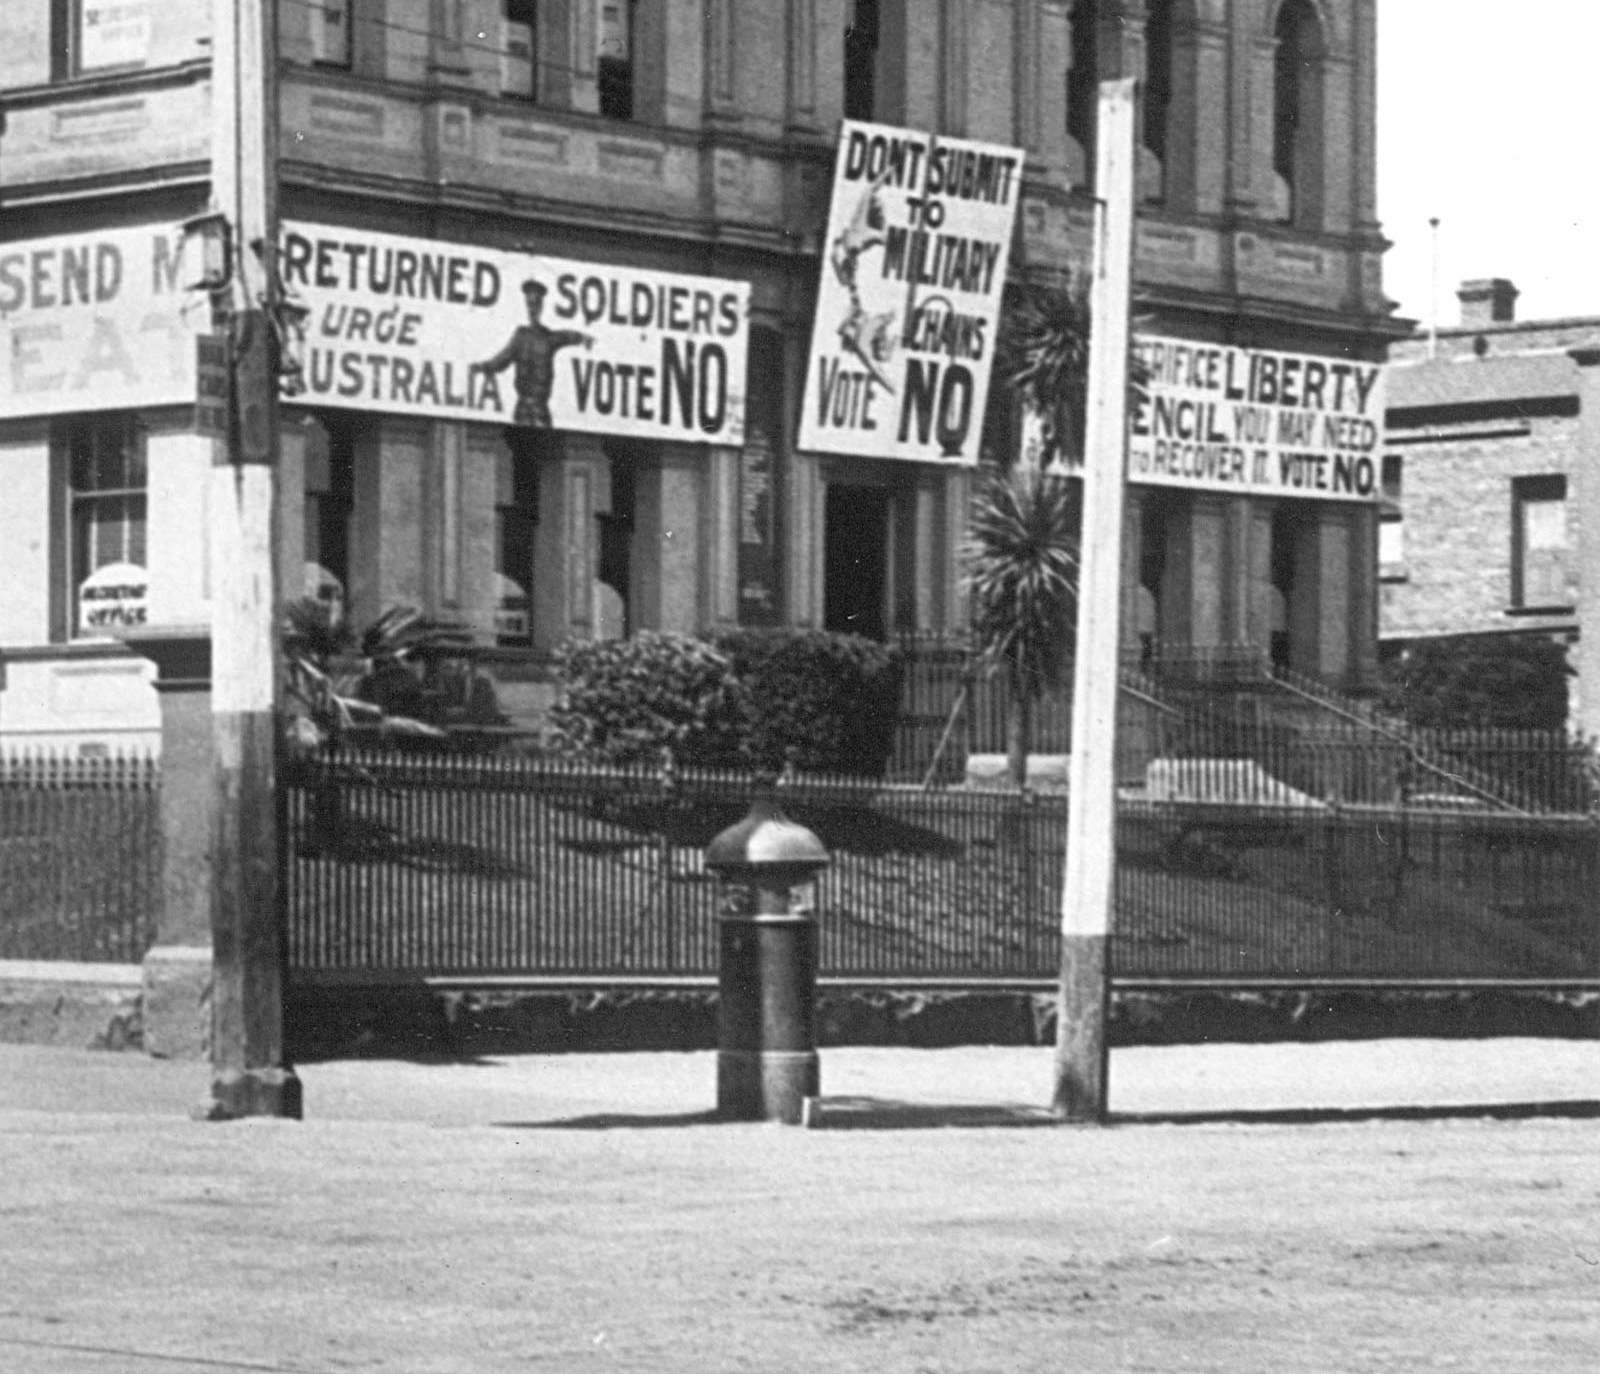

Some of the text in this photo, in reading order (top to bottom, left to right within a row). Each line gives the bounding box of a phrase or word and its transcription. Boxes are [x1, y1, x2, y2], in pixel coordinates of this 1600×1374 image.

[927, 145, 1017, 206] SUBMIT
[906, 196, 946, 229] TO
[284, 232, 501, 308] RETURNED
[555, 274, 739, 338] SOLDIERS
[882, 225, 1001, 296] MILITARY
[320, 303, 423, 347] URGE
[571, 356, 656, 422] VOTE
[660, 336, 729, 436] NO
[817, 356, 878, 431] VOTE
[897, 358, 974, 457] NO
[1133, 340, 1381, 415] RIFICE LIBERTY
[1233, 406, 1270, 444] YOU
[1276, 410, 1316, 447] MAY
[1323, 415, 1377, 453] NEED
[1154, 439, 1245, 483] RECOVER
[1279, 451, 1329, 490] VOTE
